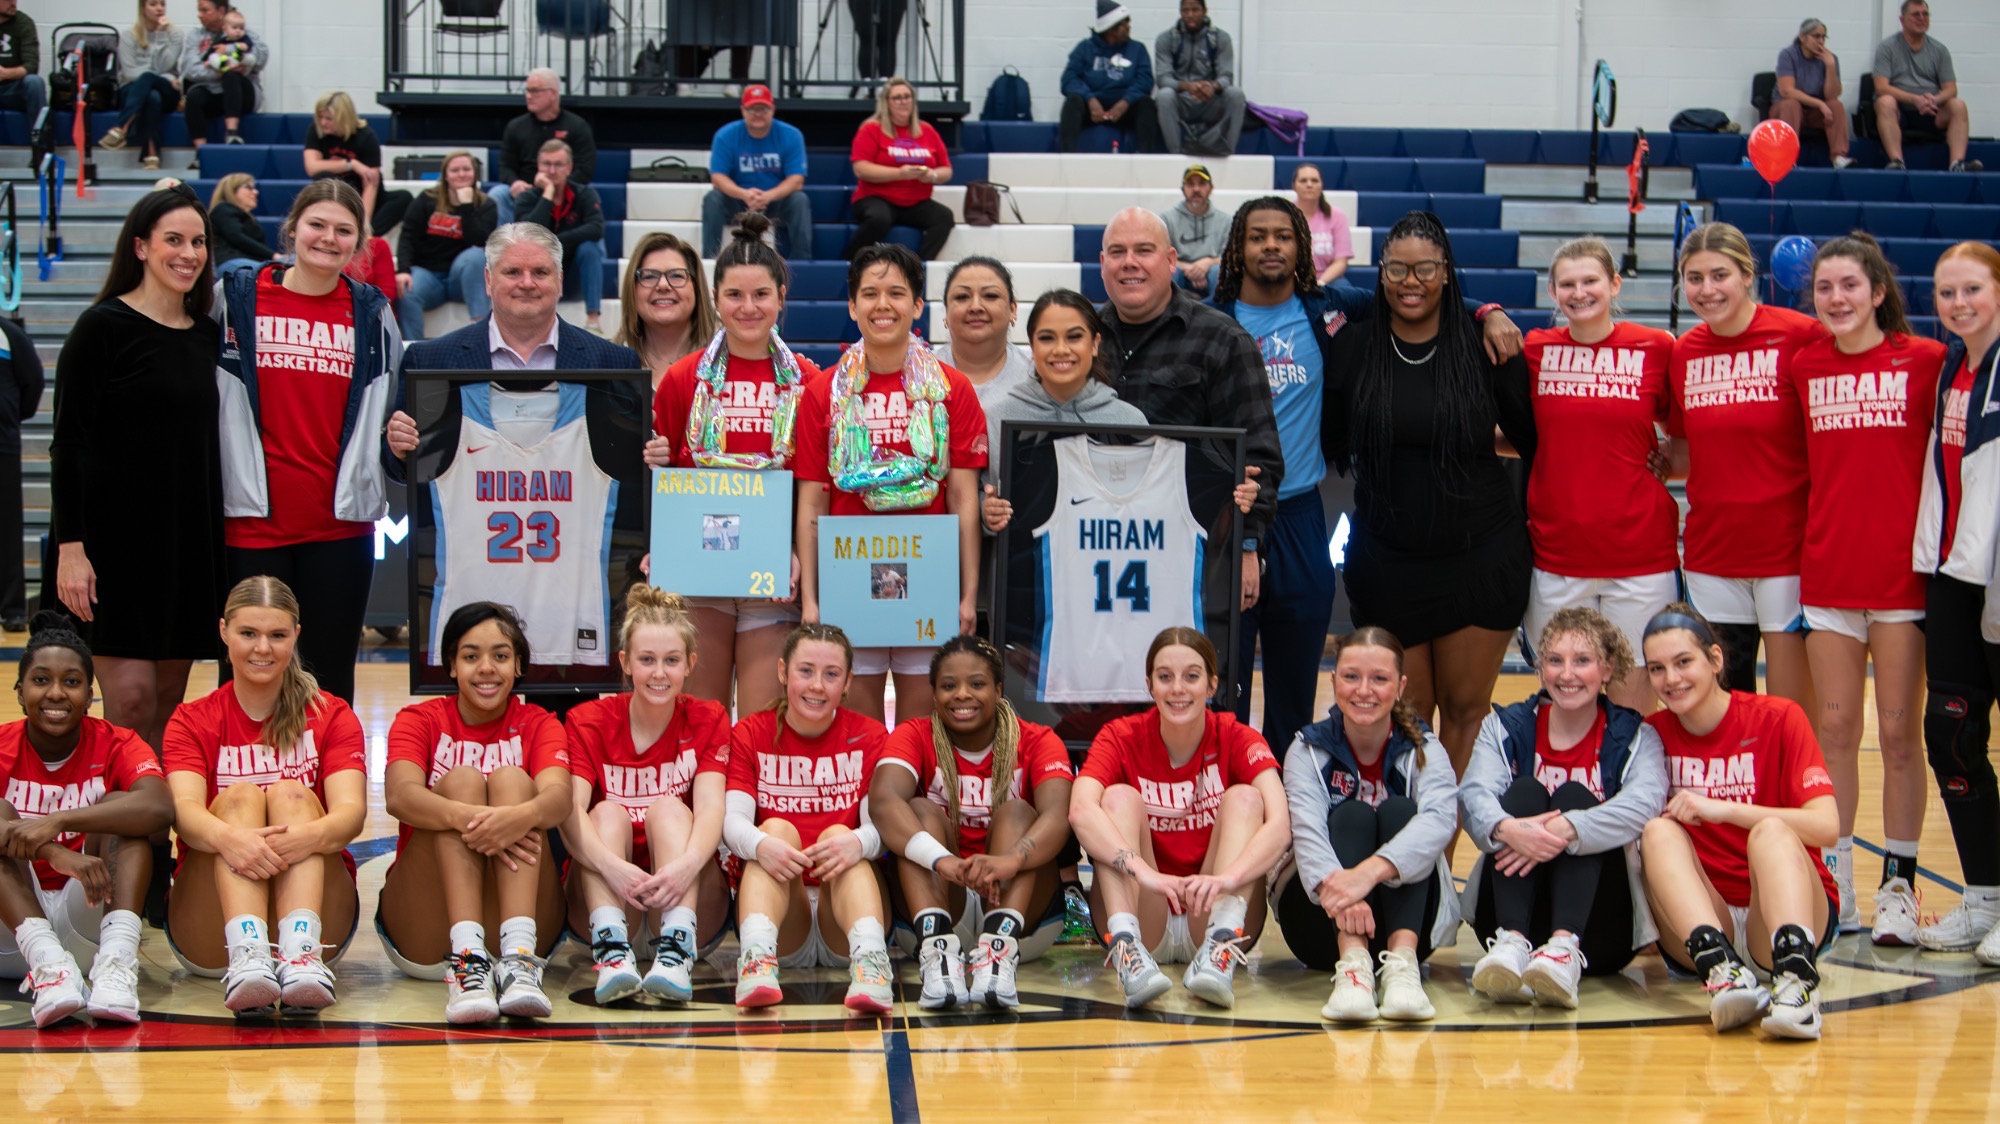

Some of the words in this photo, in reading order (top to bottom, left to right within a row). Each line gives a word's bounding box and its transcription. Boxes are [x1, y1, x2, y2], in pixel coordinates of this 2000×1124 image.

[255, 316, 355, 353] HIRAM
[1540, 345, 1645, 377] HIRAM
[1686, 349, 1779, 384] HIRAM
[1538, 382, 1640, 400] BASKETBALL
[1599, 374, 1642, 387] WOMEN'S
[1736, 376, 1777, 388] WOMEN'S
[1808, 371, 1908, 407] HIRAM
[1685, 386, 1779, 411] BASKETBALL
[1862, 401, 1906, 412] WOMEN'S
[1812, 412, 1907, 433] BASKETBALL
[476, 471, 572, 502] HIRAM
[656, 471, 765, 497] ANASTASIA
[487, 511, 560, 563] 23
[834, 535, 923, 560] MADDIE
[1079, 519, 1165, 550] HIRAM
[749, 571, 776, 596] 23
[1093, 560, 1150, 612] 14
[915, 618, 936, 641] 14
[434, 732, 523, 773] HIRAM
[602, 748, 698, 797] HIRAM
[757, 750, 864, 786] HIRAM
[1666, 752, 1755, 787] IRAM
[5, 776, 106, 815] HIRAM
[758, 791, 859, 813] BASKETBALL
[820, 780, 861, 797] WOMEN'S
[1711, 784, 1756, 798] WOMEN'S
